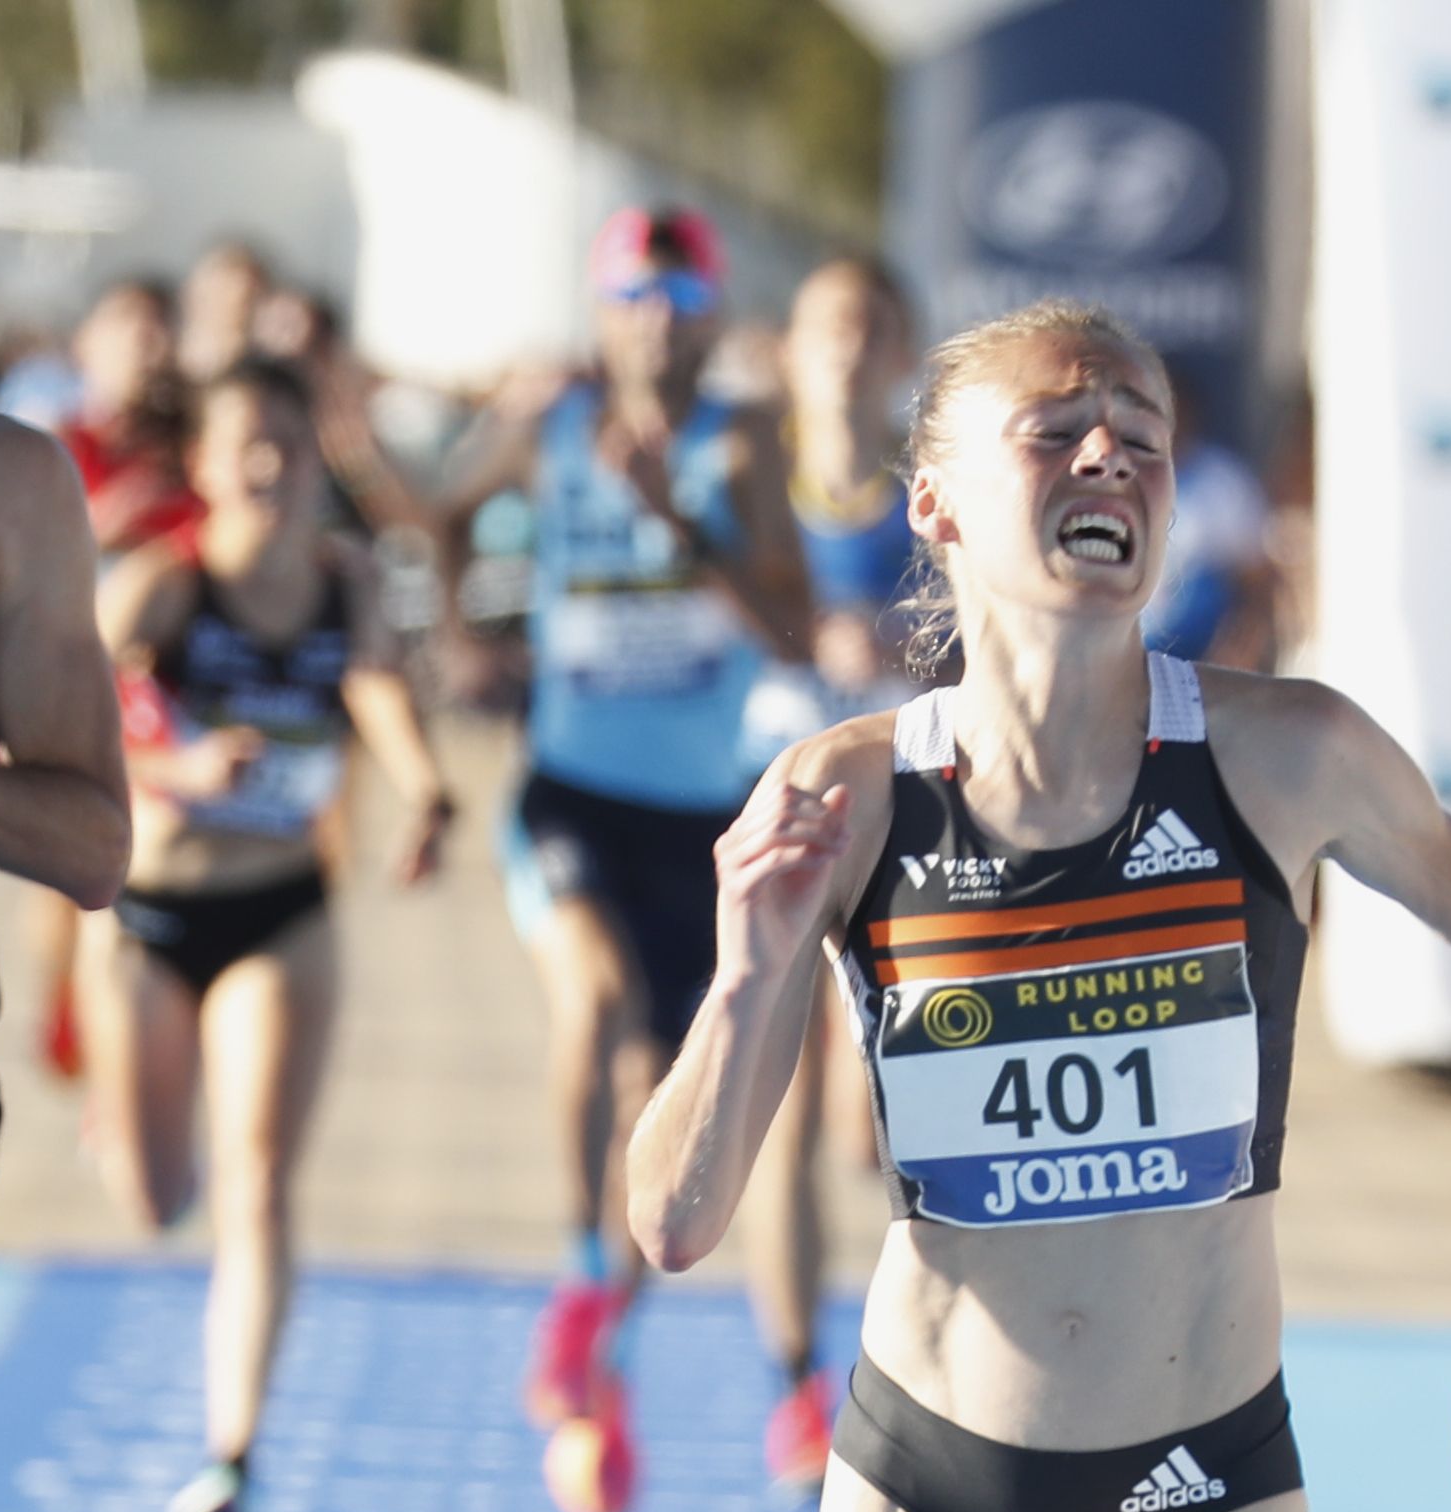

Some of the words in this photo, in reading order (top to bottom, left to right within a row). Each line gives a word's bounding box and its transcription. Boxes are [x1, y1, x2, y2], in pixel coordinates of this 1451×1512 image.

[942, 857, 1007, 876] VICKY
[1122, 847, 1219, 880] adidas
[948, 874, 1001, 889] FOODS
[1017, 960, 1205, 1006] RUNNING
[1069, 1001, 1178, 1034] LOOP
[982, 1047, 1158, 1139] 401
